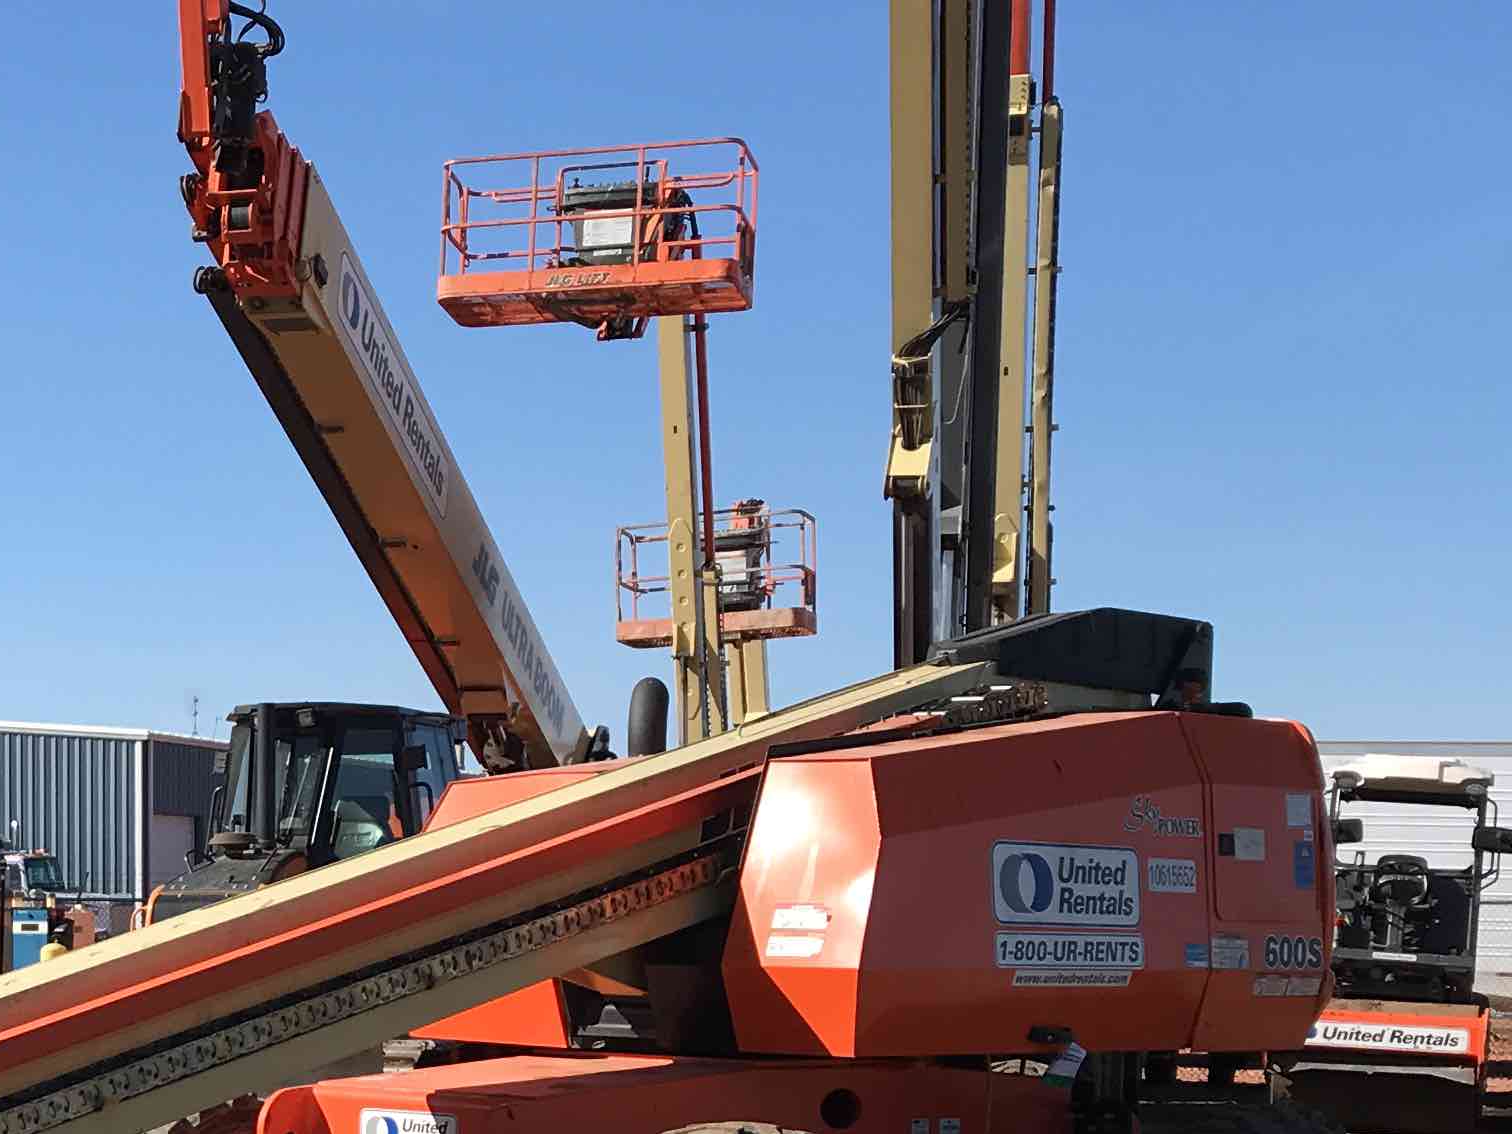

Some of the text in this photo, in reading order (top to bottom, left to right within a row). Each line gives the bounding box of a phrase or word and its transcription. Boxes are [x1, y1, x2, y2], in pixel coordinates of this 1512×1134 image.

[360, 317, 447, 497] United Rentals
[501, 593, 534, 681] ULTRA
[1057, 856, 1127, 886] United
[1058, 887, 1134, 918] Rentals
[999, 940, 1140, 962] 1-800-UR-RENTS
[1264, 935, 1322, 969] 600S
[1323, 1025, 1460, 1049] United Rentals
[402, 1119, 449, 1134] United
